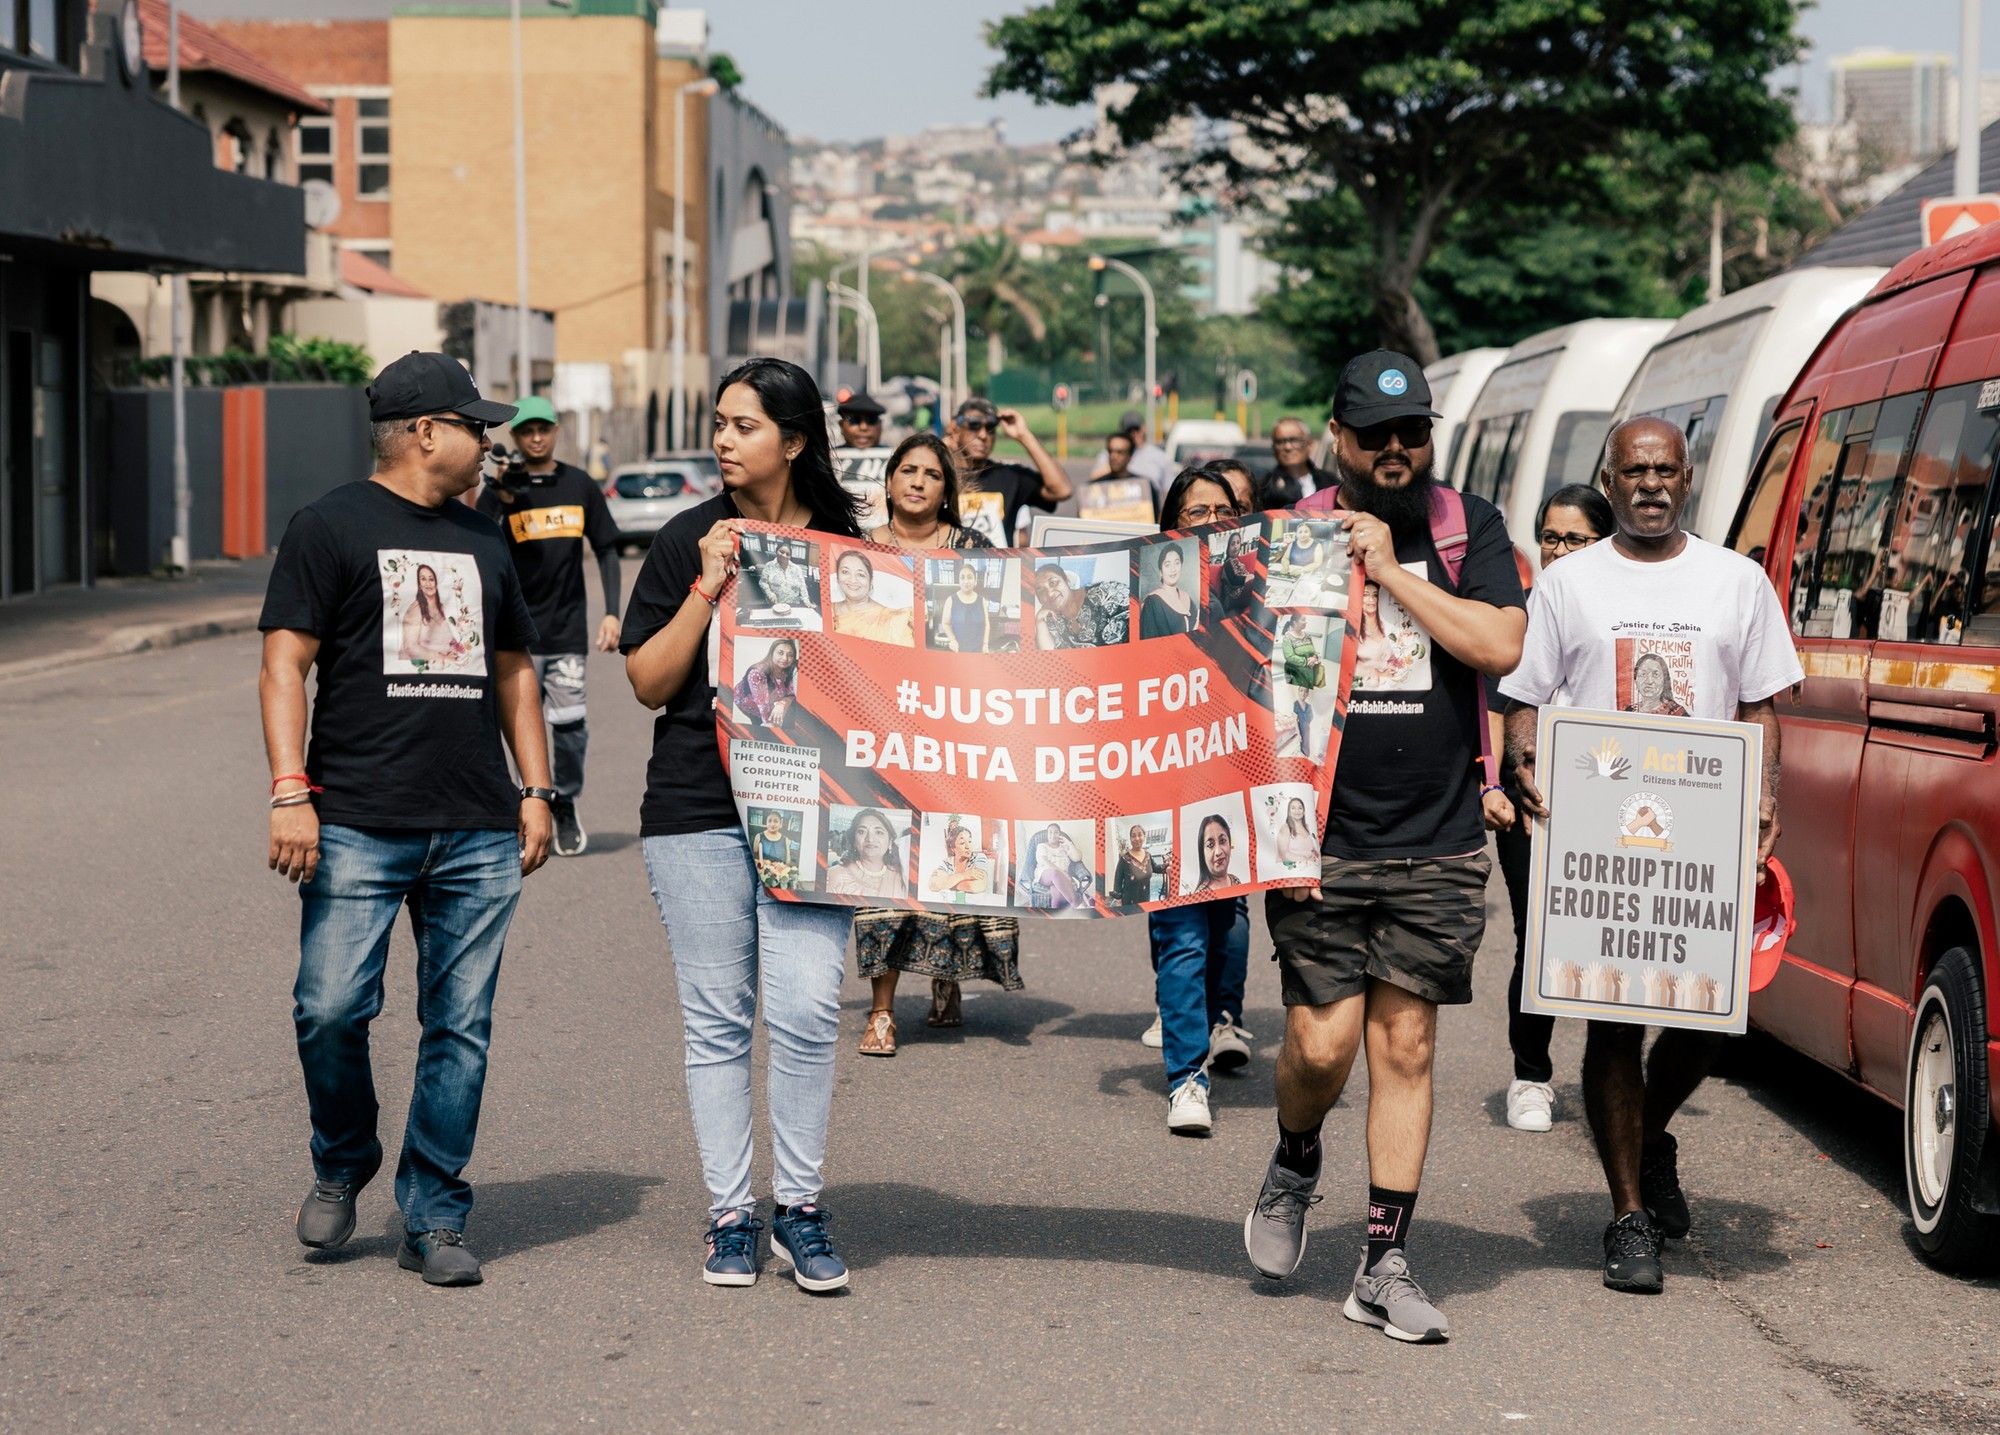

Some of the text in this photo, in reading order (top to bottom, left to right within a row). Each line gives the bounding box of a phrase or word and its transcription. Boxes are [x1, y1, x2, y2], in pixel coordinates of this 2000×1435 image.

[1611, 621, 1701, 632] Justice for Babita
[1640, 639, 1691, 654] SPEAKING
[1665, 655, 1693, 669] TRUTH
[1674, 670, 1688, 678] TO
[386, 683, 483, 699] #JusticeForBabitaDeokaran
[897, 667, 1209, 725] #JUSTICE FOR
[1673, 680, 1695, 711] POWER
[1347, 700, 1424, 714] eForBabitaDeokaran
[741, 740, 817, 757] REMEMBERING
[845, 713, 1248, 783] BABITA DEOKARAN
[734, 752, 754, 761] THE
[757, 755, 807, 768] COURAGE
[1643, 746, 1723, 777] Active
[742, 767, 812, 781] CORRUPTION
[1642, 774, 1722, 790] Citizens Movement
[754, 780, 799, 791] FIGHTER
[1563, 851, 1715, 894] CORRUPTION
[1549, 885, 1734, 932] ERODES HUMAN
[1600, 926, 1687, 964] RIGHTS
[1369, 1205, 1386, 1219] BE
